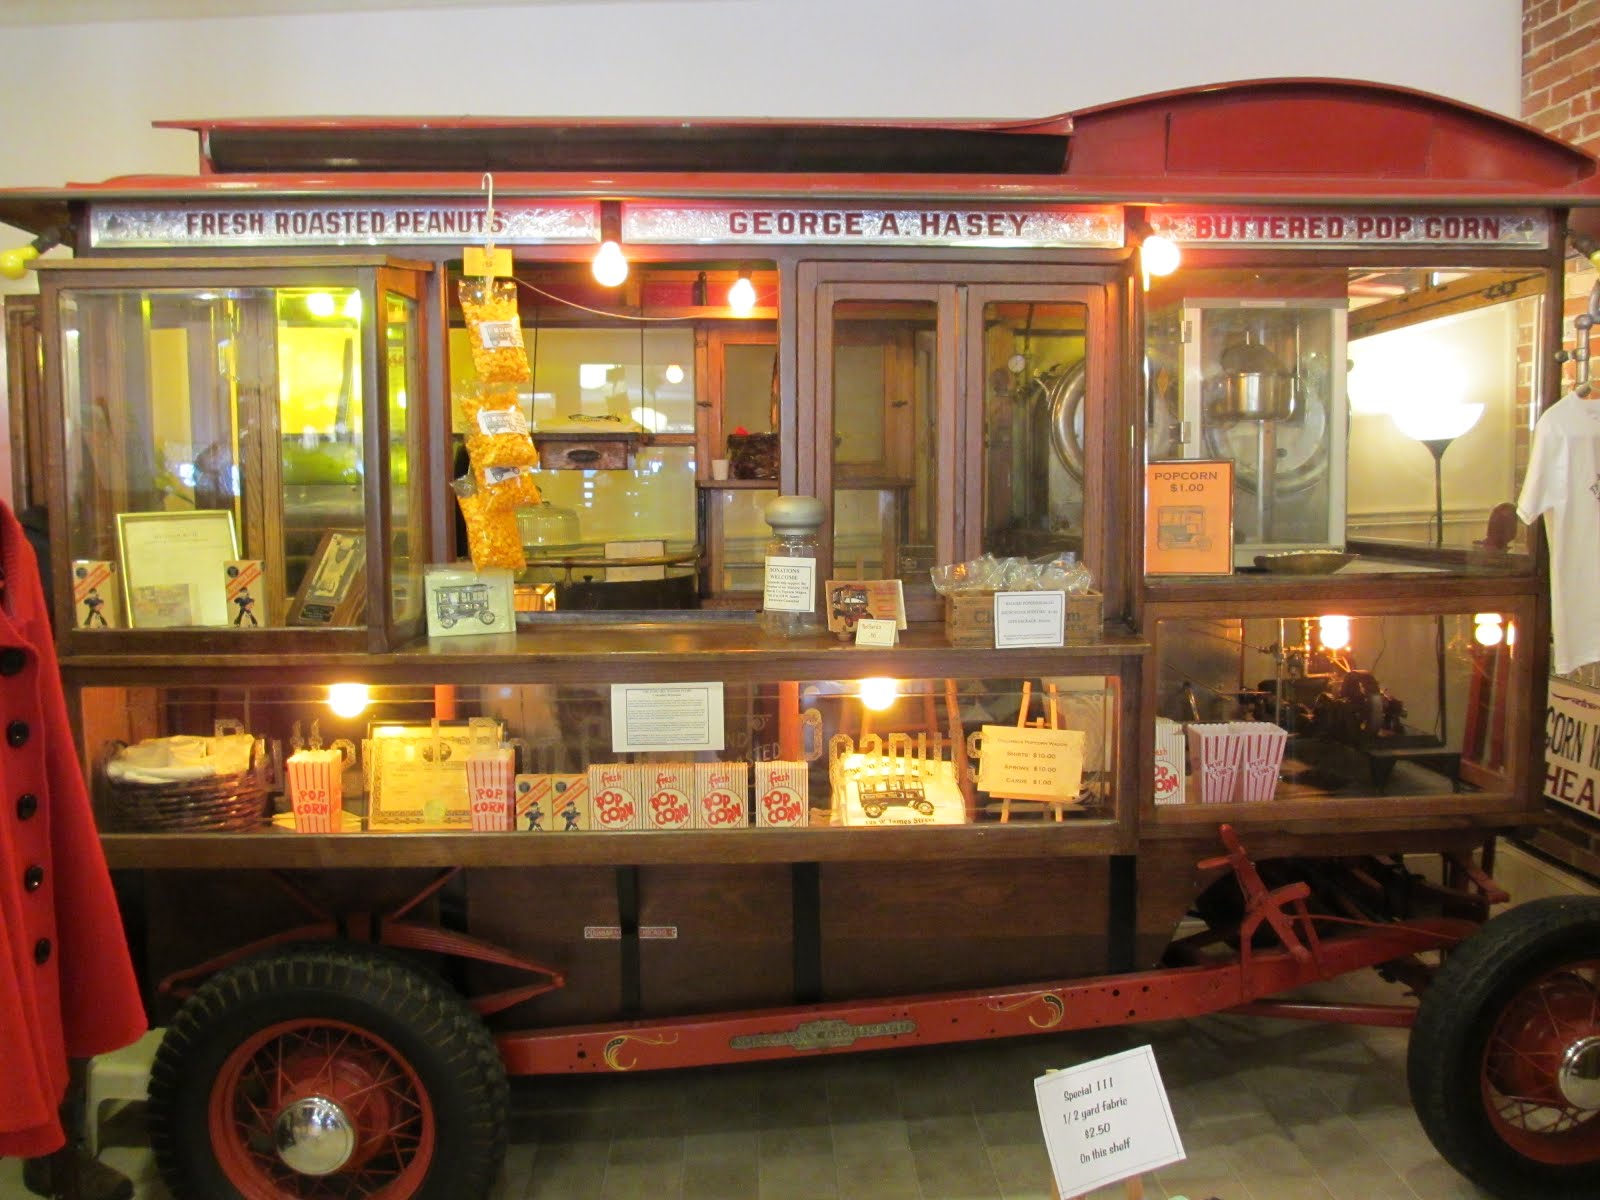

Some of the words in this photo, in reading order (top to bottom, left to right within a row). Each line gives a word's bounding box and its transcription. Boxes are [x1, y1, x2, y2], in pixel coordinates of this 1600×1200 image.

[187, 212, 264, 235] FRESH
[275, 210, 386, 235] ROASTED
[395, 210, 502, 234] PEANUTS
[729, 212, 864, 236] GEORGE
[879, 212, 911, 236] A.
[921, 212, 1029, 237] HASEY
[1196, 216, 1345, 240] BUTTERED
[1357, 216, 1413, 240] POP
[1424, 216, 1501, 240] CORN
[1154, 472, 1218, 481] POPCORN
[1169, 483, 1205, 493] $1.00
[1546, 706, 1587, 763] CORN
[1033, 752, 1057, 760] $10.00
[1207, 760, 1223, 770] POP
[1249, 758, 1266, 769] POP
[1033, 766, 1057, 774] $10.00
[1209, 765, 1234, 780] CORN
[1251, 764, 1276, 779] CORN
[476, 788, 503, 800] POP
[1154, 774, 1180, 794] ORN
[299, 790, 326, 801] POP
[595, 790, 623, 810] POP
[649, 792, 678, 812] POP
[703, 791, 731, 812] POP
[763, 790, 791, 810] POP
[296, 803, 328, 815] CORN
[473, 802, 505, 813] CORN
[600, 801, 634, 824] CORN
[655, 802, 689, 825] CORN
[707, 802, 742, 825] CORN
[767, 801, 801, 824] CORN
[1064, 1083, 1092, 1102] Special
[1081, 1103, 1100, 1121] yard
[1102, 1097, 1128, 1112] fabric
[1084, 1122, 1111, 1139] $2.50
[1080, 1153, 1091, 1164] On
[1092, 1148, 1107, 1160] this
[1109, 1136, 1131, 1154] shelf
